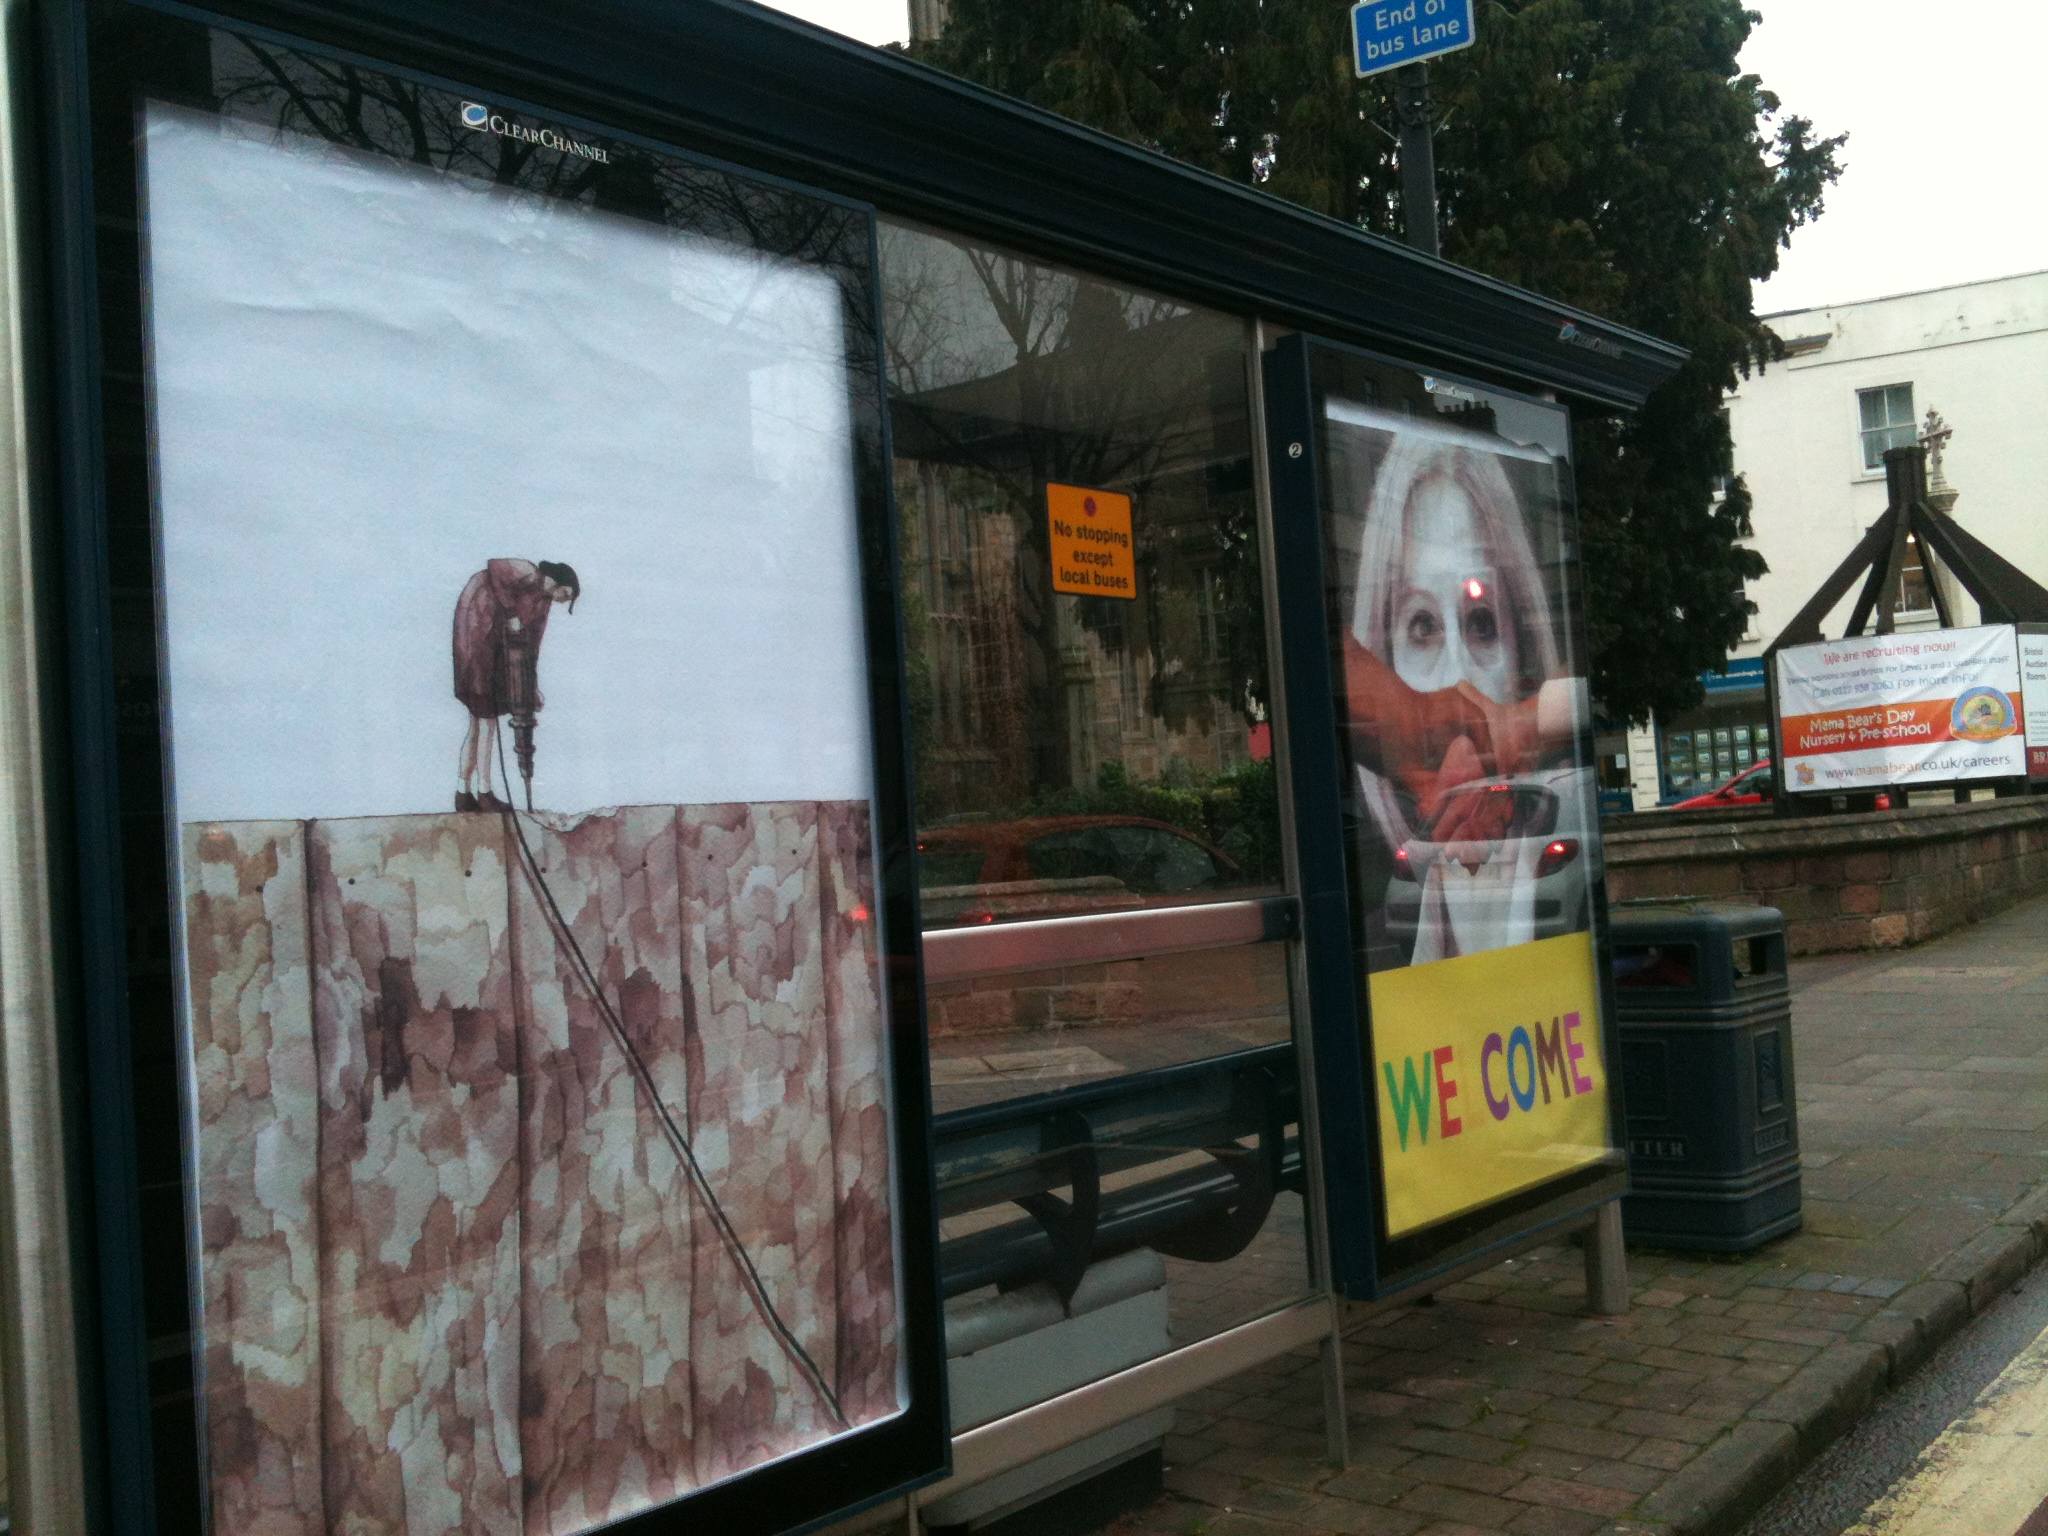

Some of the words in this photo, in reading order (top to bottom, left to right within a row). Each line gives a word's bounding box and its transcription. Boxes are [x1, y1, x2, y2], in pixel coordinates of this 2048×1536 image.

[1375, 0, 1416, 31] End
[1366, 36, 1405, 59] bus
[1412, 19, 1460, 46] lane
[1054, 520, 1073, 538] No
[1076, 524, 1129, 549] stopping
[1072, 550, 1113, 568] except
[1059, 565, 1091, 585] local
[1094, 570, 1129, 590] buses
[1824, 653, 1840, 666] We
[1843, 651, 1859, 663] are
[1862, 644, 1921, 659] recruiting
[1919, 675, 1948, 686] more
[1810, 718, 1845, 733] Mama
[1846, 712, 1882, 729] Bear's
[1886, 709, 1916, 725] Day
[1800, 732, 1846, 749] Nursery
[1860, 722, 1932, 742] Pre-school
